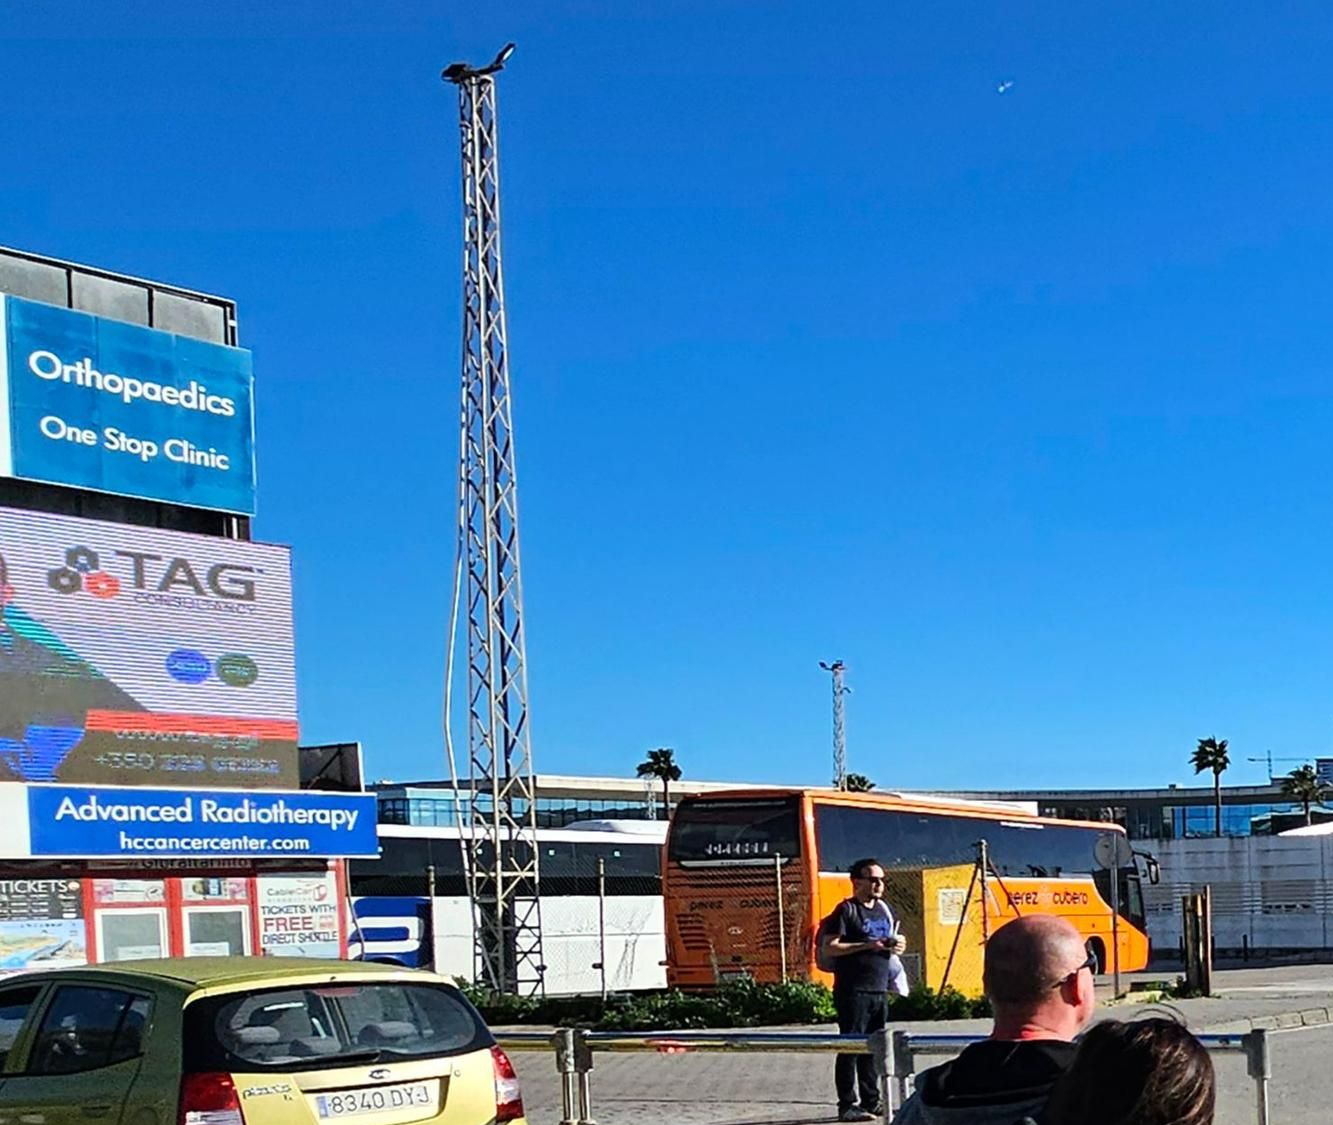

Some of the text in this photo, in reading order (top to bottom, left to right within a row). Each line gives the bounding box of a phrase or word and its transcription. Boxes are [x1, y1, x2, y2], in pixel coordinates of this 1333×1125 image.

[29, 351, 235, 417] Orthopaedics
[40, 416, 230, 470] One Stop Clinic
[115, 551, 255, 601] TAG
[55, 796, 358, 830] Advanced Radiotherapy
[120, 831, 310, 851] hccancercenter.com
[0, 880, 68, 894] TICKETS
[1052, 888, 1088, 905] cubero
[261, 904, 336, 915] TICKETS WITH
[263, 916, 314, 932] FREE
[262, 933, 297, 945] DIRECT
[331, 1091, 386, 1114] 8340
